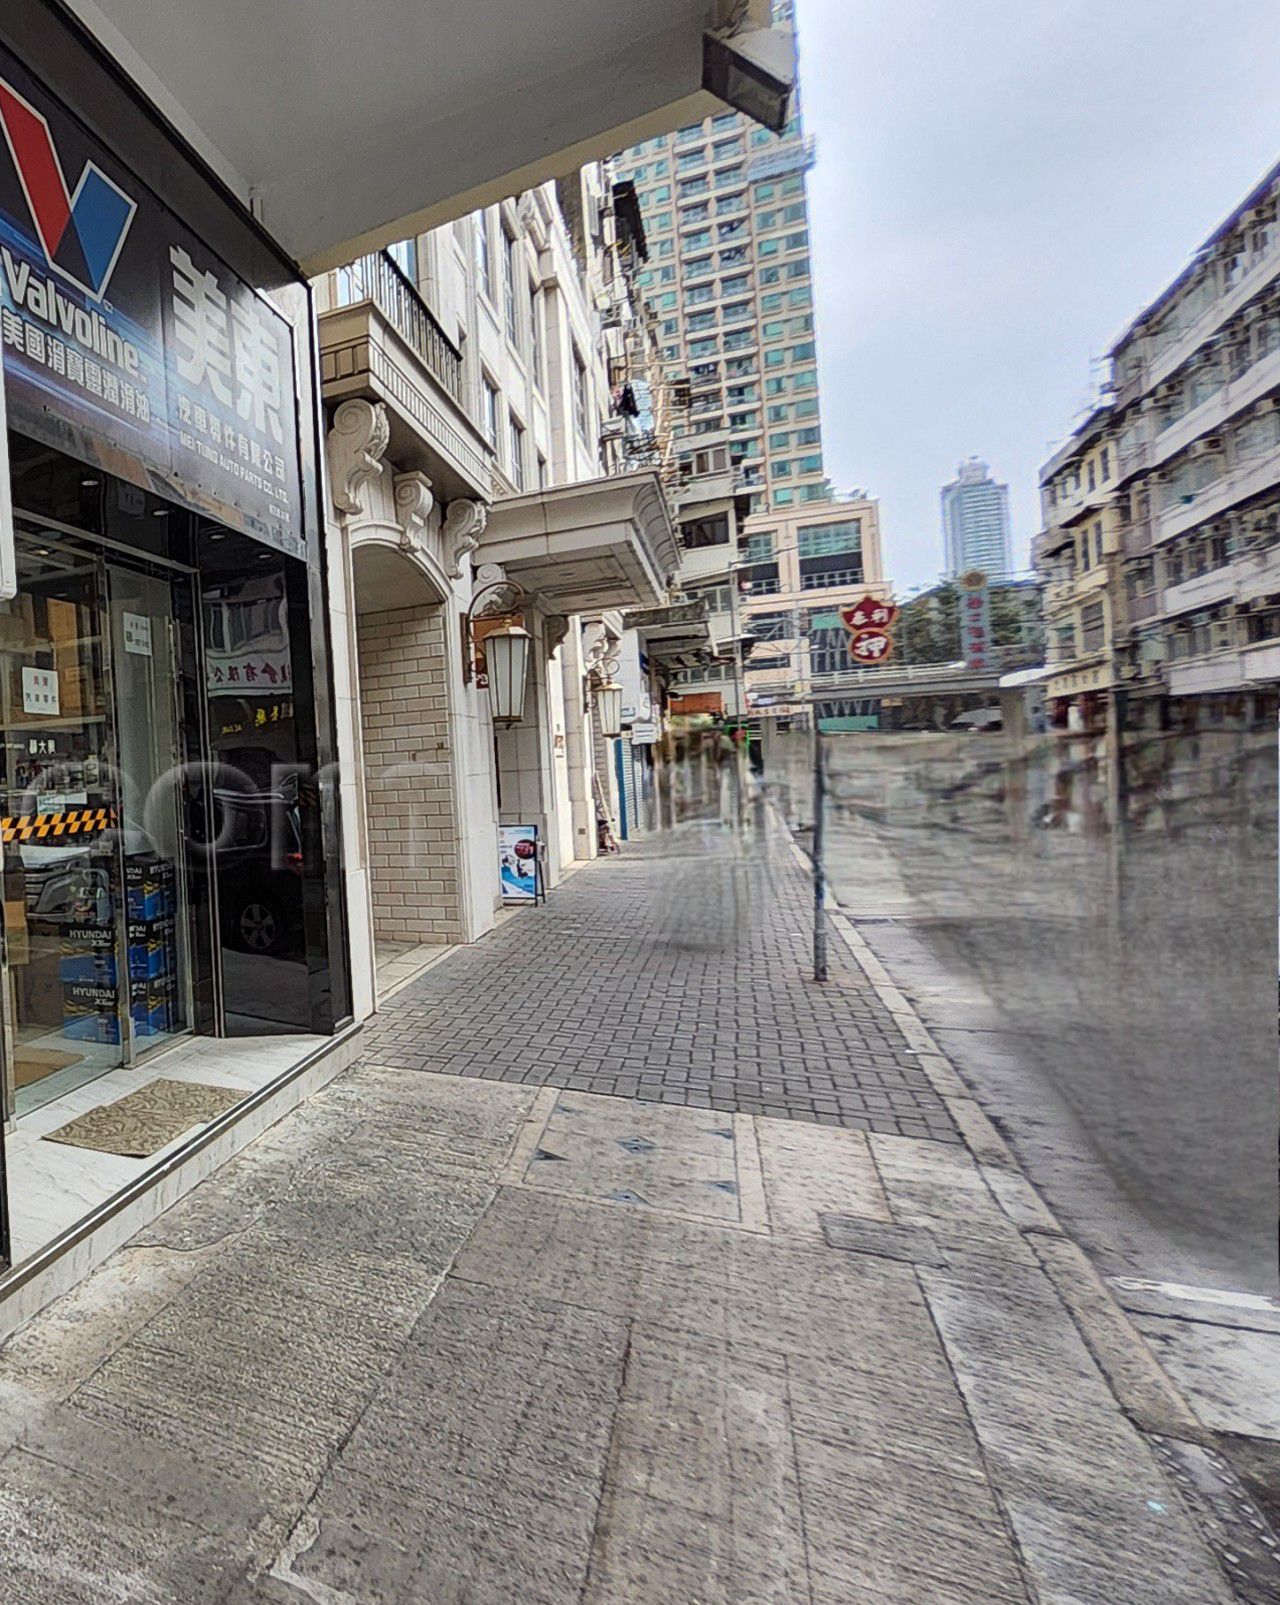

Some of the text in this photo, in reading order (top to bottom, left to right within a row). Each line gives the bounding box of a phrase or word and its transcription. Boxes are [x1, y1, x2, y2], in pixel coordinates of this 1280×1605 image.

[0, 245, 140, 379] Valvoline
[169, 243, 285, 446] 美東
[219, 453, 240, 477] AUTO
[240, 465, 262, 490] PARTS
[69, 929, 112, 939] HYUNDAI
[72, 986, 115, 998] HYUNDAI
